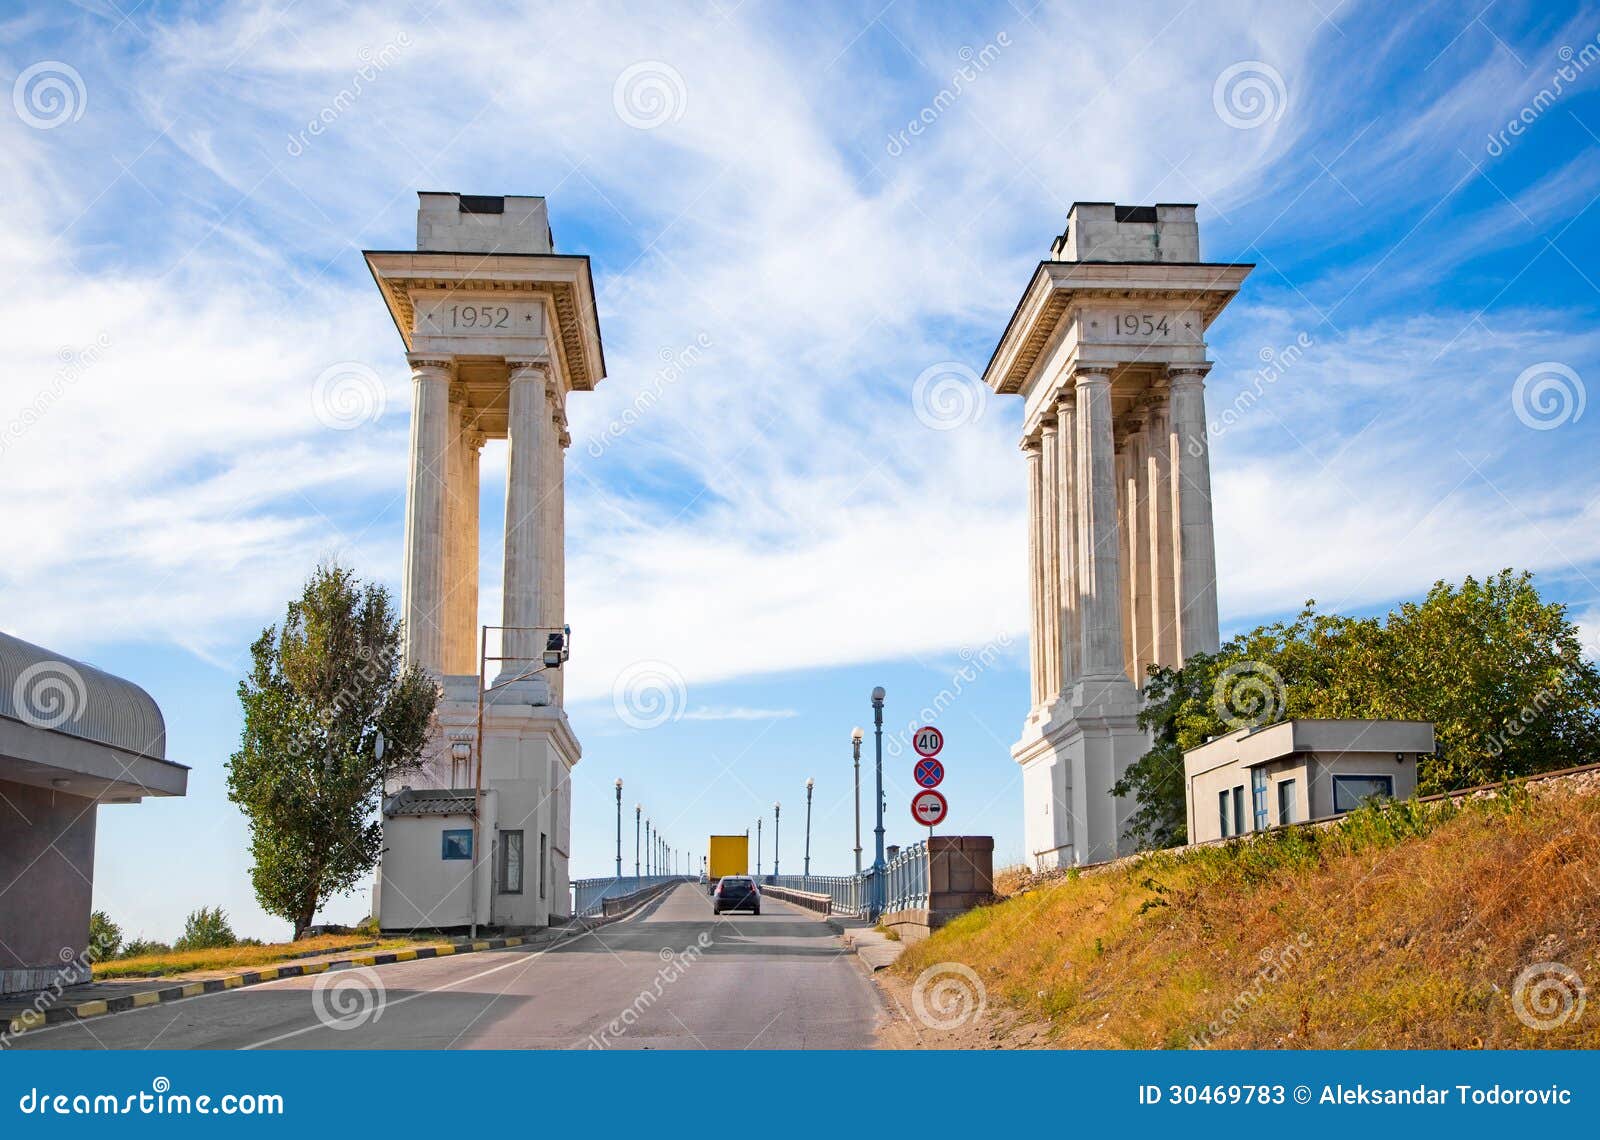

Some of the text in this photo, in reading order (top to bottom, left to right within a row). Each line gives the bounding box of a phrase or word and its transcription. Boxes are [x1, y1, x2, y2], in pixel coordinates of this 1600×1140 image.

[450, 305, 509, 328] 1952
[1114, 314, 1170, 336] 1954
[919, 734, 938, 749] 40
